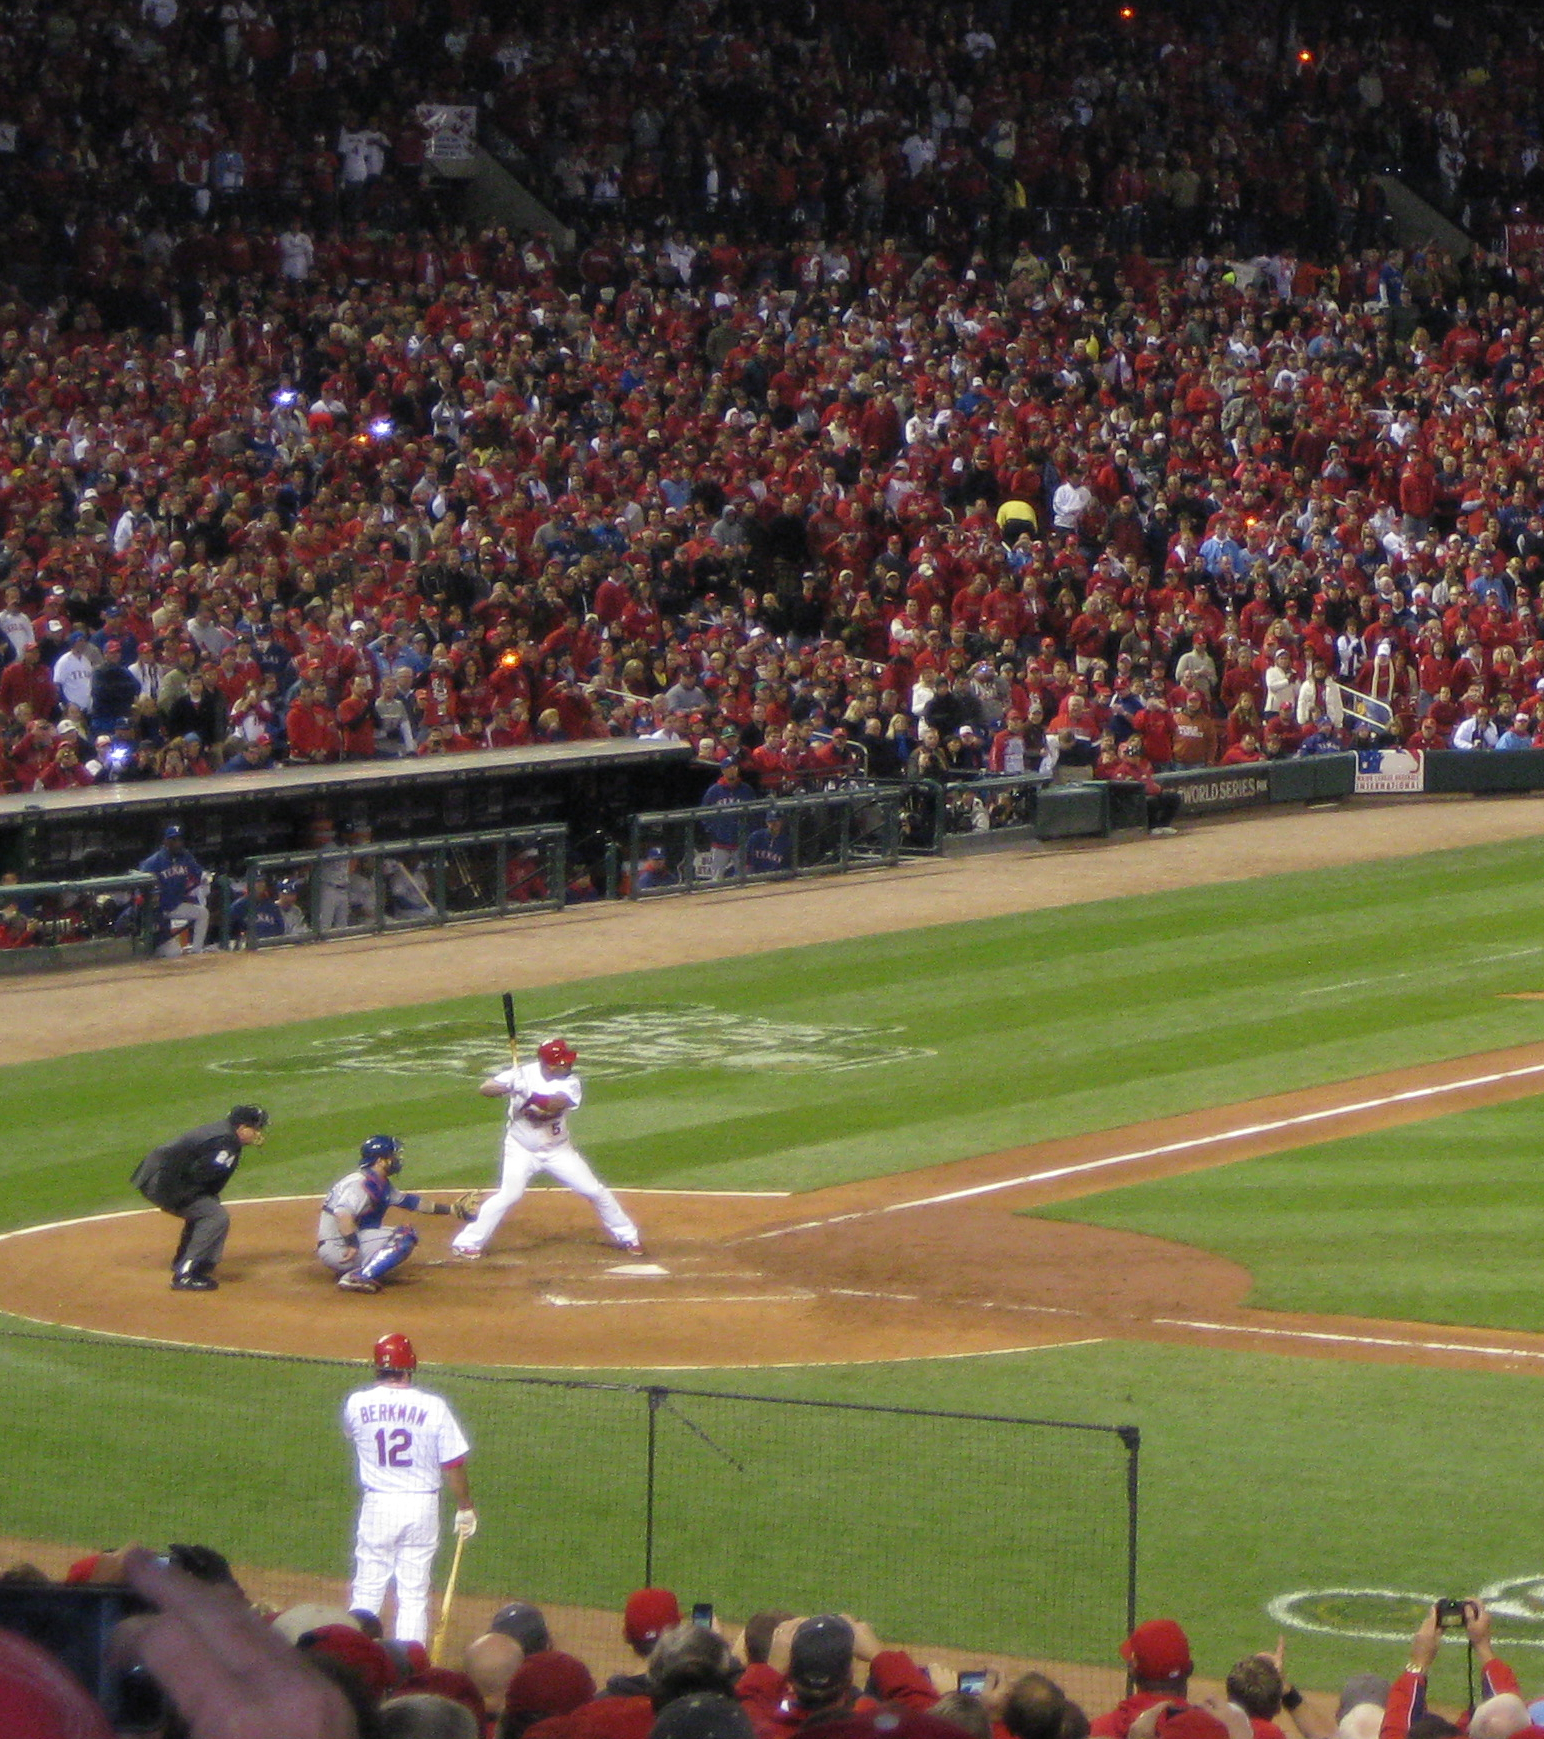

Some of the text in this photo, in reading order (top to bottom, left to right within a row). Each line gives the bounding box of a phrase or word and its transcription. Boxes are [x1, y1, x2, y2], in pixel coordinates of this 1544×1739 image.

[1181, 782, 1219, 804] WORLD
[1219, 778, 1256, 800] SERIES
[1355, 781, 1420, 790] INTERNATIONAL
[359, 1402, 429, 1428] BERKMAN
[374, 1427, 414, 1468] 12
